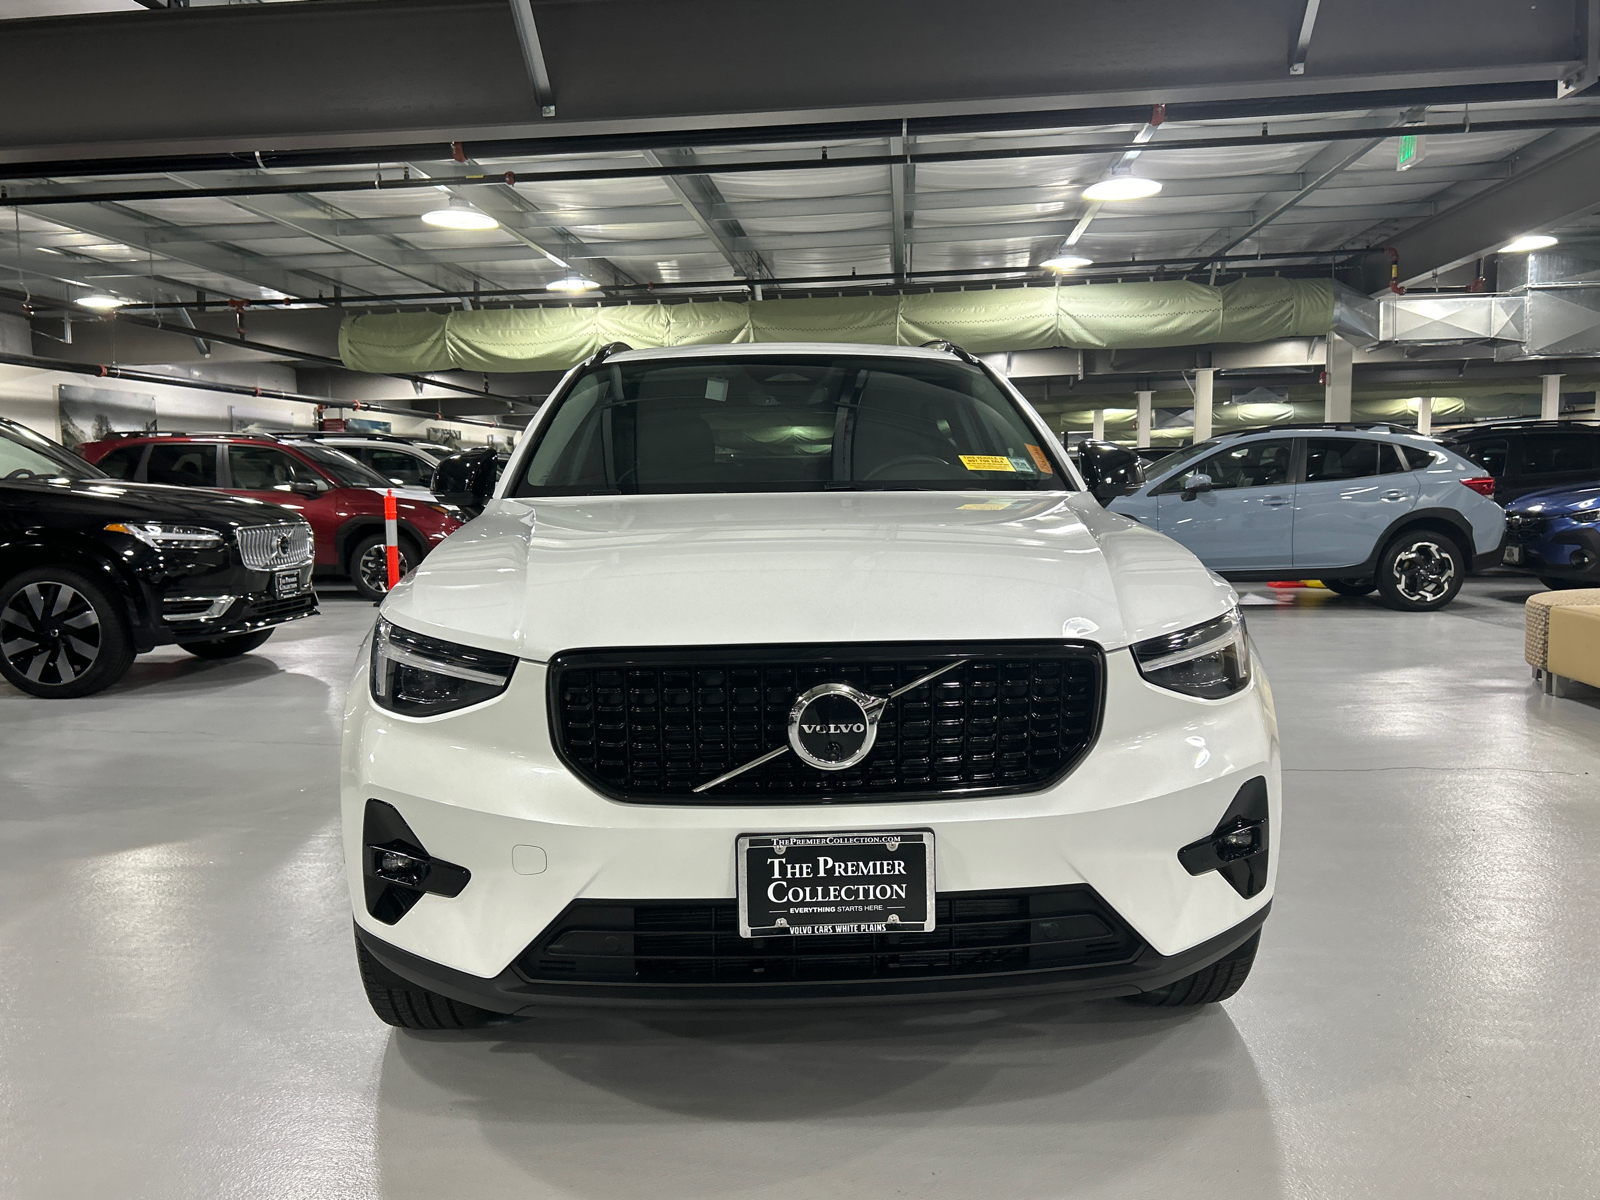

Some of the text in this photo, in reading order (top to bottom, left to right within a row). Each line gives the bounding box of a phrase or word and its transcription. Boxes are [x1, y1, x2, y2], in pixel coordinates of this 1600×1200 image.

[801, 723, 865, 734] VOLVO
[771, 836, 901, 846] THEPREMIERCOLLECTION.COM
[767, 856, 907, 879] THE PREMIER
[767, 883, 907, 903] COLLECTION
[790, 906, 836, 914] EVERYTHING
[789, 923, 887, 935] VOLVO CARS WHITE PLAINS
